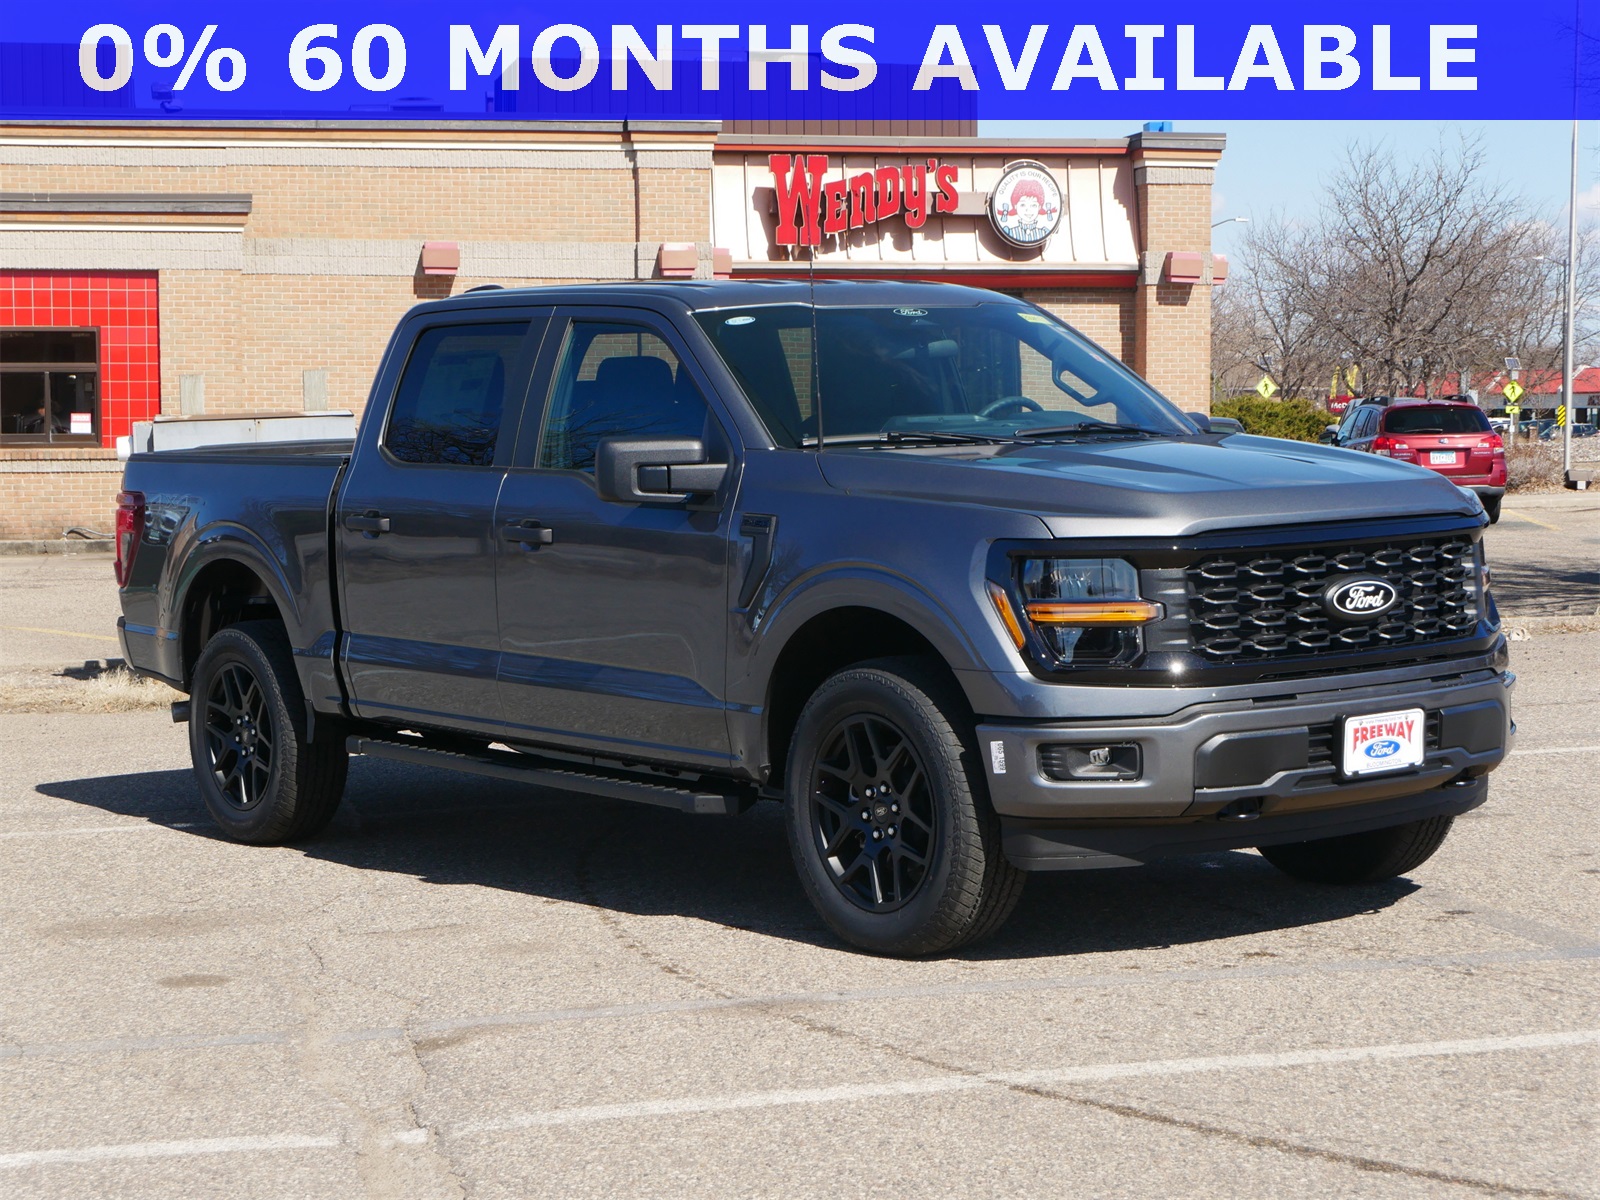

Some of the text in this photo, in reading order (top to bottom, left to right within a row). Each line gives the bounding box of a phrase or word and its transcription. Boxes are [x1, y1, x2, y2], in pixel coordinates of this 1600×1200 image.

[998, 174, 1019, 195] QUALITY
[1027, 171, 1042, 180] OUR
[1042, 176, 1058, 197] RECIPE
[1345, 585, 1385, 610] Ford
[1353, 719, 1415, 755] FREEWAY
[1370, 740, 1395, 757] Ford
